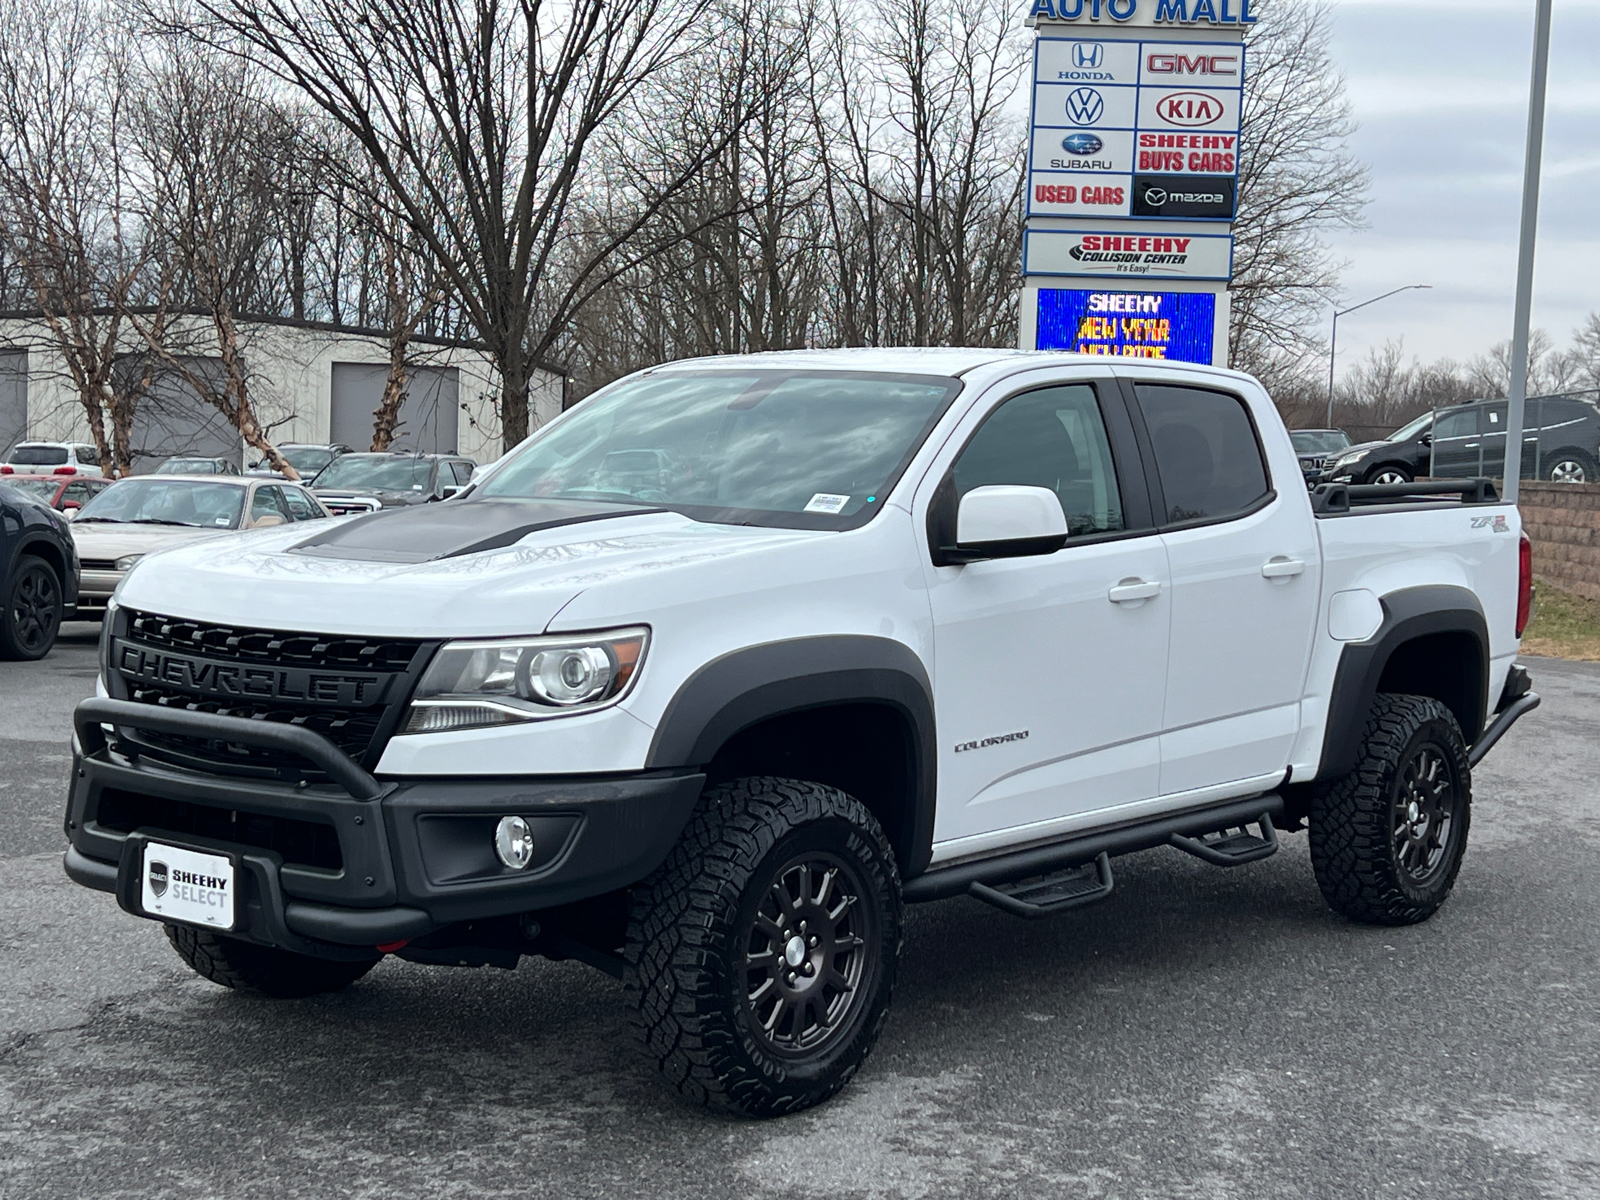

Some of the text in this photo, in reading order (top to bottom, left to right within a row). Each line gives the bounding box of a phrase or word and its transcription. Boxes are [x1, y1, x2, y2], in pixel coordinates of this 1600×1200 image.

[1154, 0, 1258, 24] MALL
[1147, 54, 1237, 76] GMC
[1057, 71, 1115, 81] HONDA
[1168, 100, 1212, 119] KIA
[1139, 134, 1236, 149] SHEEHY
[1050, 159, 1112, 169] SUBARU
[1139, 151, 1235, 172] BUYS CARS
[1035, 185, 1125, 205] USED CARS
[1082, 236, 1191, 253] SHEEHY
[1082, 252, 1188, 264] COLLISION CENTER
[1117, 264, 1149, 273] It's Easy!
[1089, 294, 1162, 313] SHEEHY
[119, 647, 380, 704] CHEVROLET
[954, 730, 1029, 753] COLORADO
[172, 869, 228, 890] SHEEHY
[172, 884, 228, 908] SELECT
